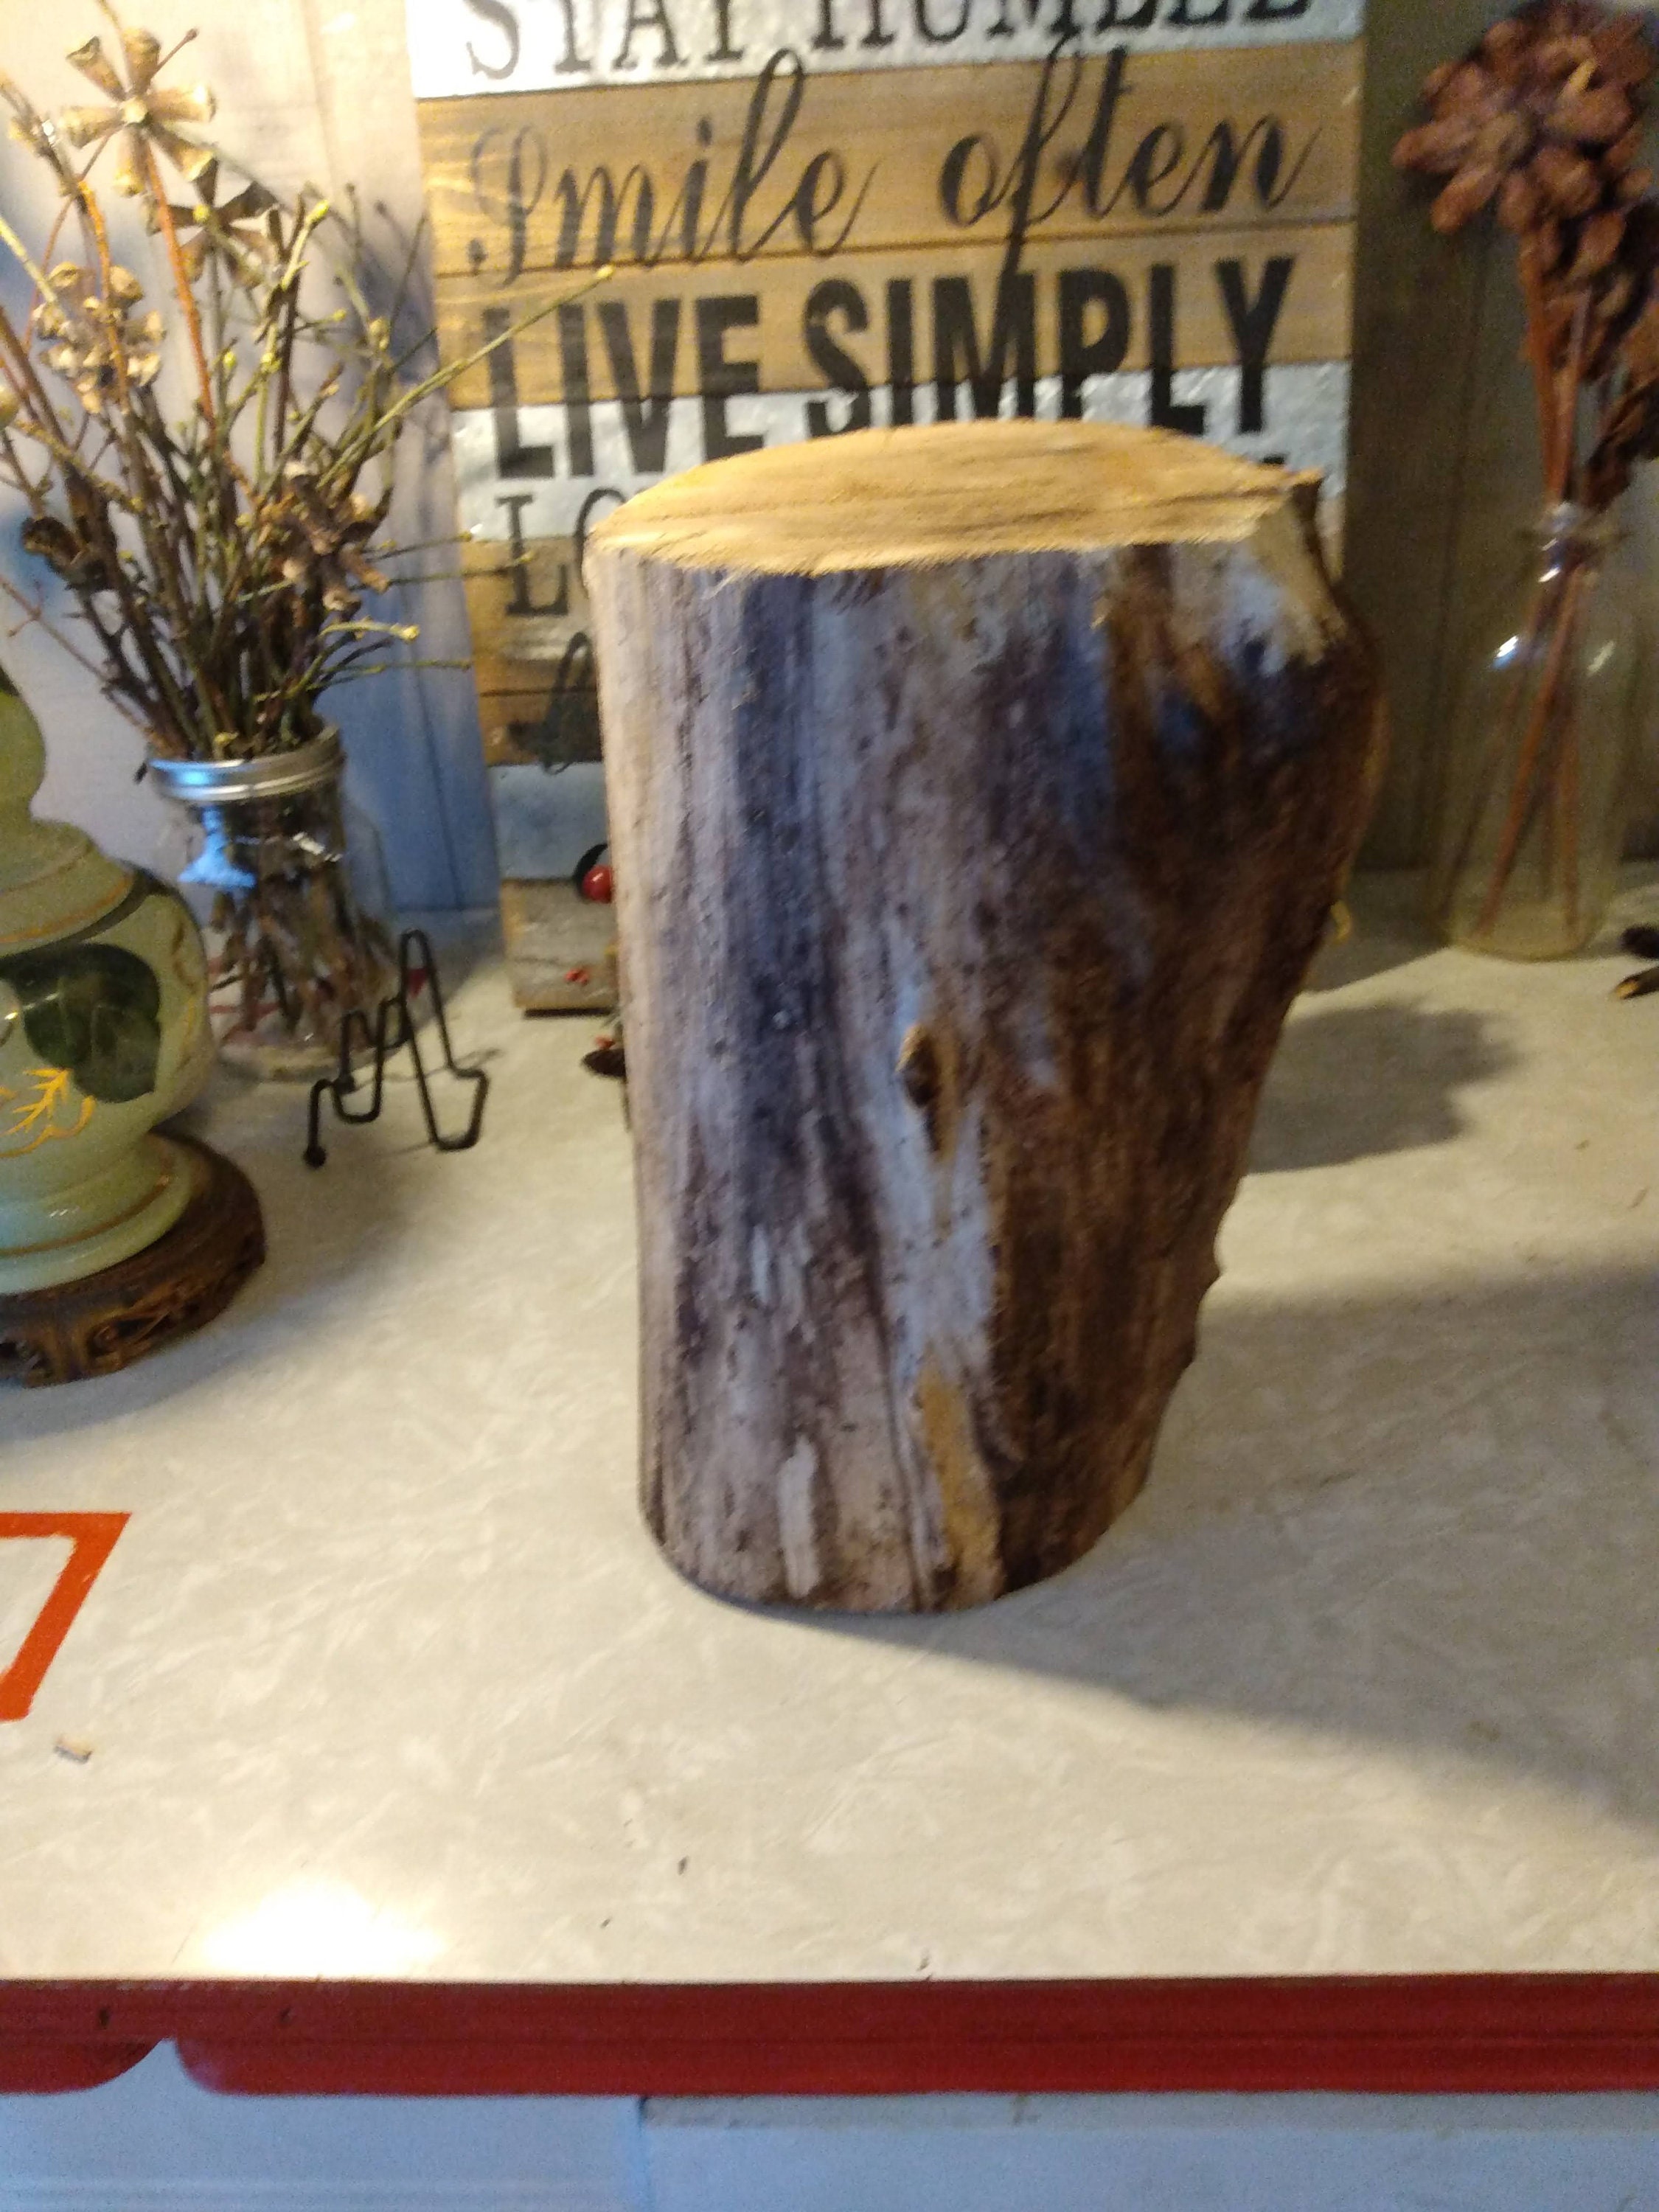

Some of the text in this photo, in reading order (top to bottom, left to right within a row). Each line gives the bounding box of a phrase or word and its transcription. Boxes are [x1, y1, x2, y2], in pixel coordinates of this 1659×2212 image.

[466, 31, 1325, 286] Smile often
[482, 253, 1293, 479] LIVE SIMPLY
